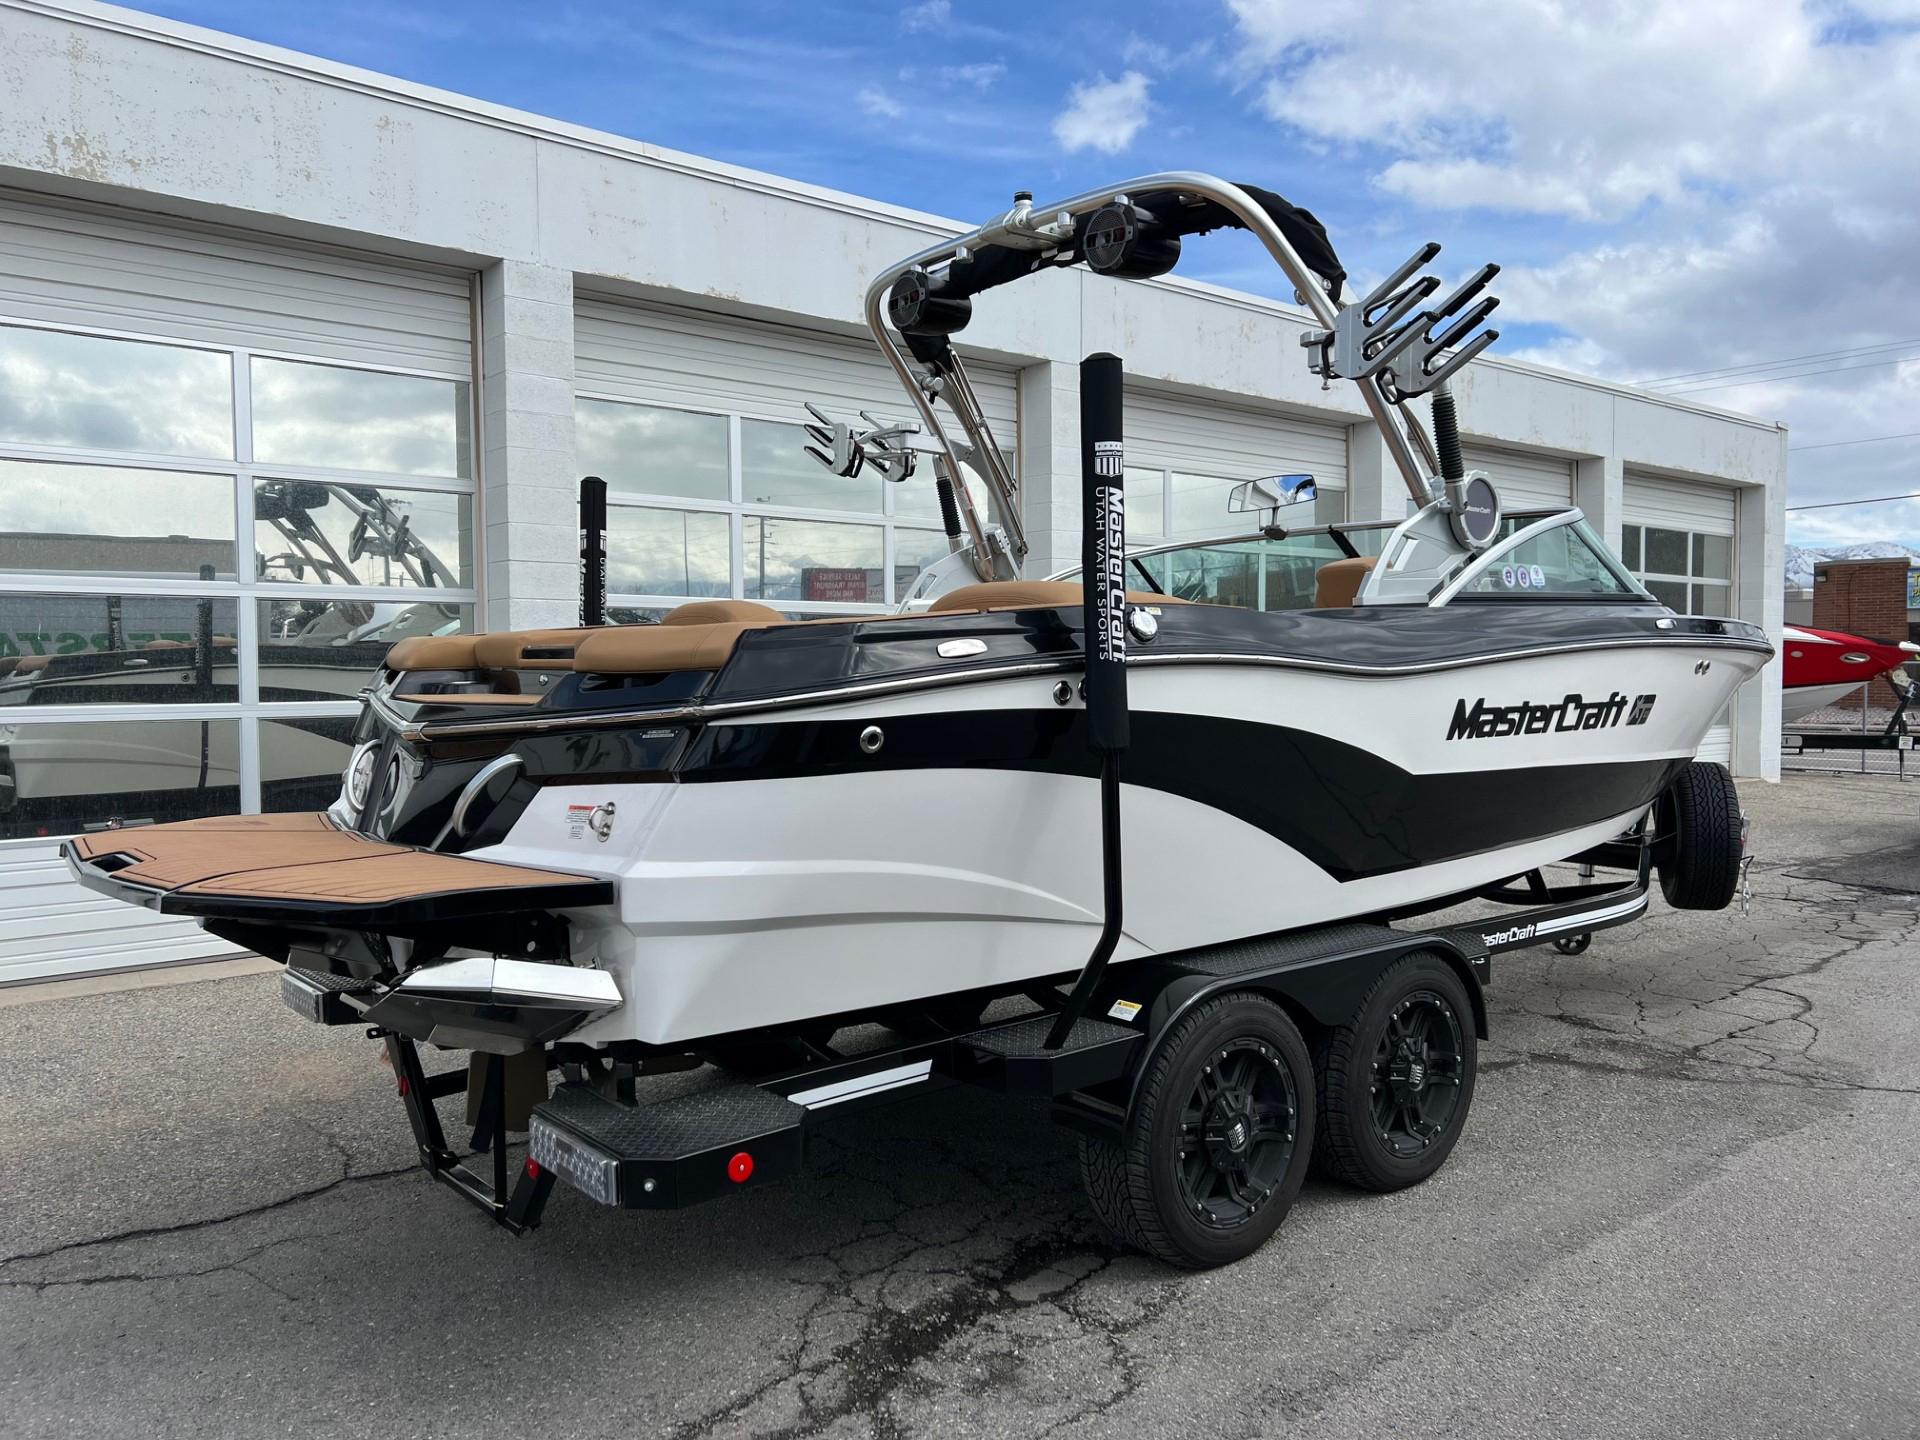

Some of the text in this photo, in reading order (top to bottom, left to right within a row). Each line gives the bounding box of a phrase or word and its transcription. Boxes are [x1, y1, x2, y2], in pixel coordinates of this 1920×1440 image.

[1095, 486, 1109, 660] UTAH WATER SPORTS
[1108, 486, 1125, 663] MasterCraft
[1446, 691, 1628, 740] MasterCraft
[1482, 924, 1535, 946] asterCraft
